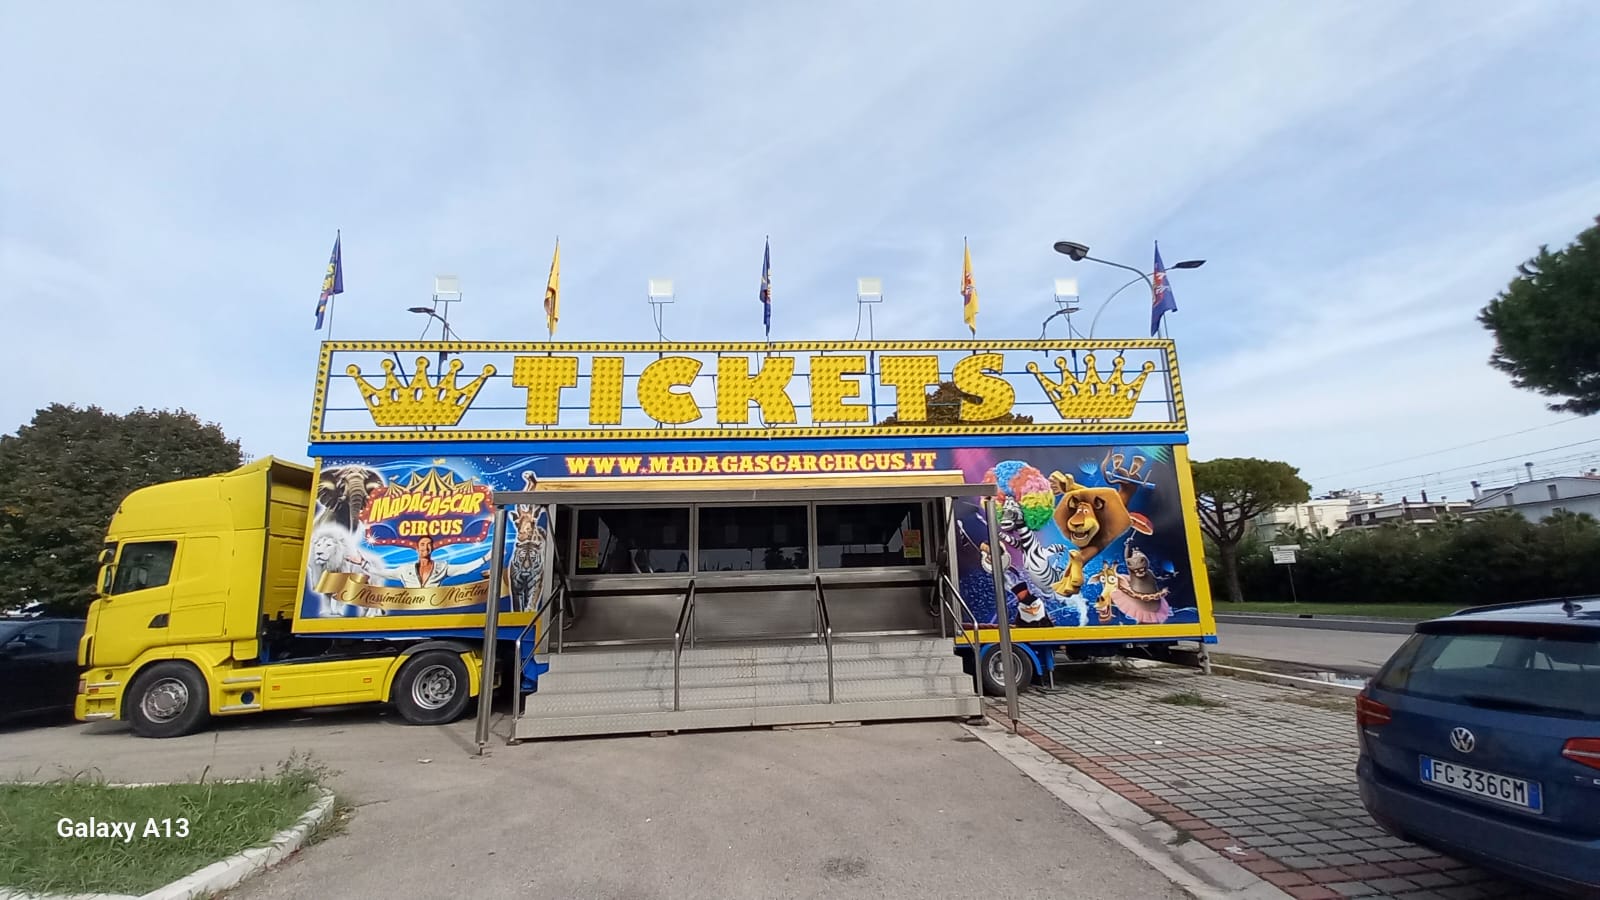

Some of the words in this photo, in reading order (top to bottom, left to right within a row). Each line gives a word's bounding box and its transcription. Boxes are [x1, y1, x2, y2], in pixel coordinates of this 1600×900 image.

[512, 352, 1016, 425] TICKETS
[565, 452, 938, 475] WWW.MADAGASCARCIRCUS.IT
[369, 492, 485, 522] MADAGASCAR
[399, 520, 463, 537] CIRCUS
[341, 588, 426, 606] Massimiliano
